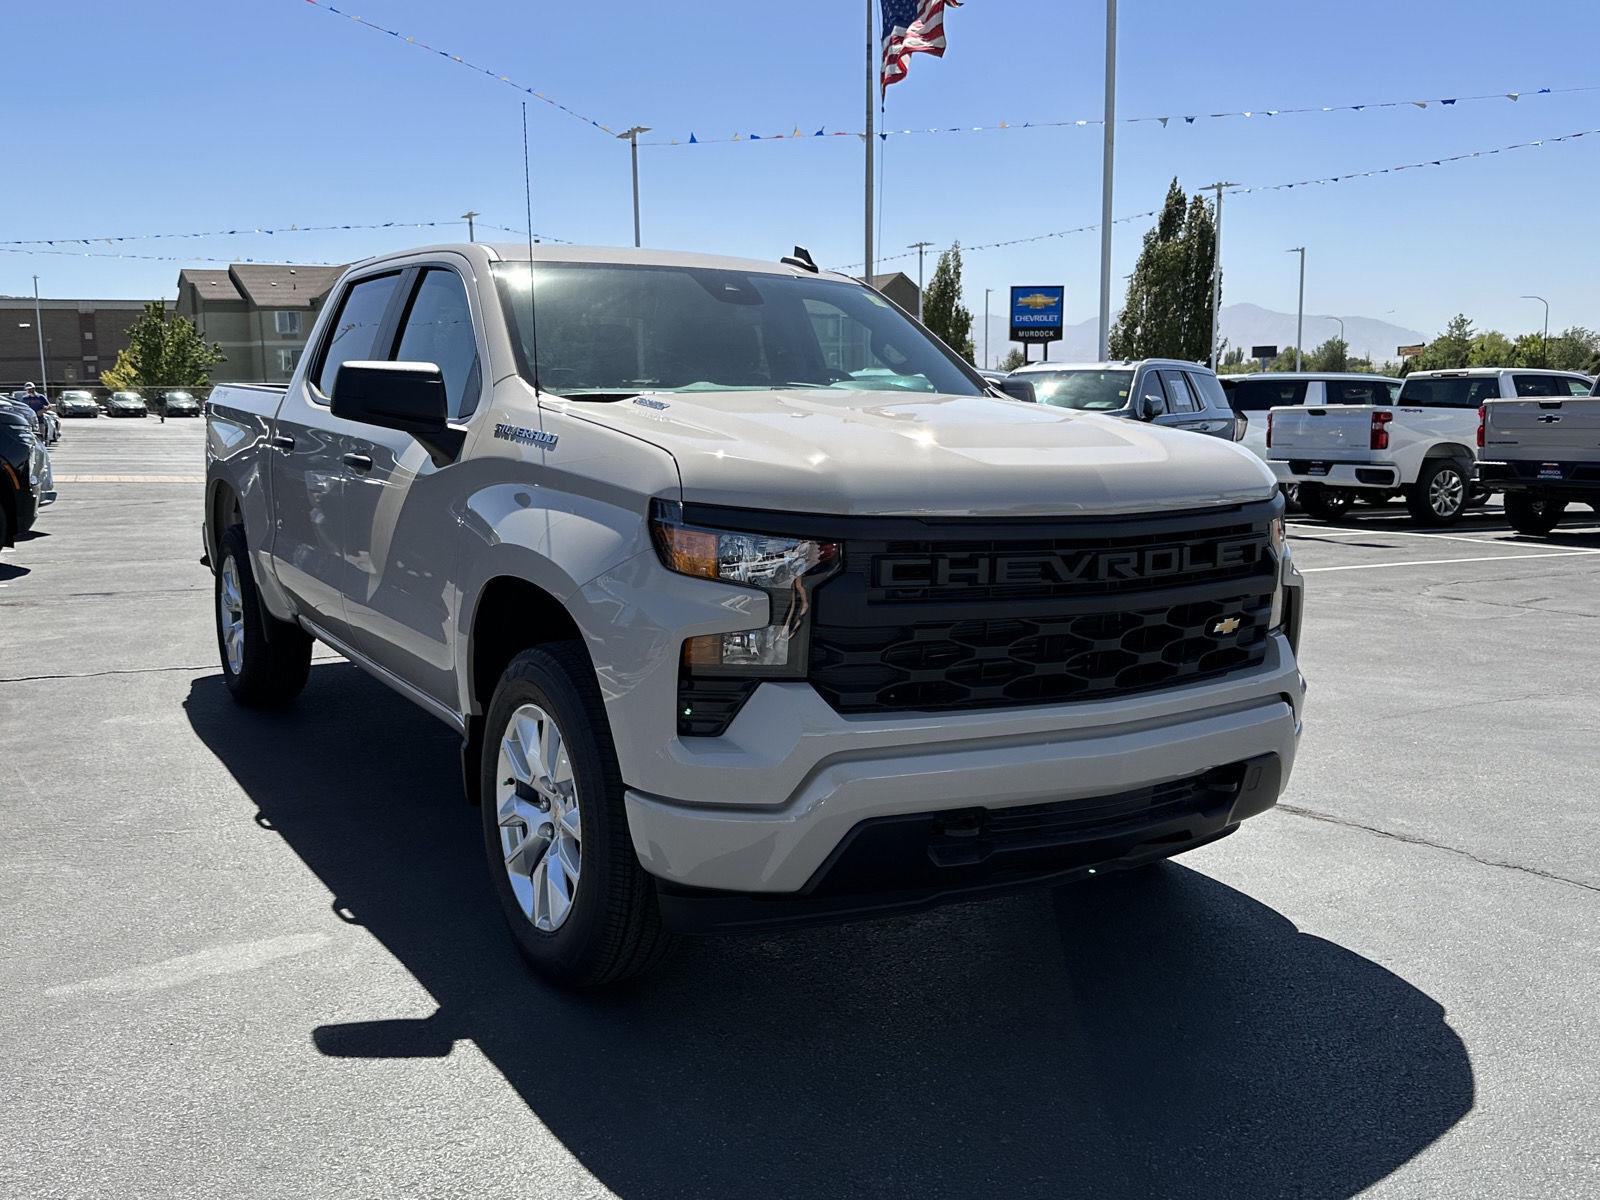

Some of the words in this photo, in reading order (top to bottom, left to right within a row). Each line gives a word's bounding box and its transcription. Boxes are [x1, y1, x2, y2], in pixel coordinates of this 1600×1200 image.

[1015, 314, 1058, 322] CHEVROLET
[495, 423, 558, 447] SILVERADO
[881, 539, 1268, 586] CHEVROLET
